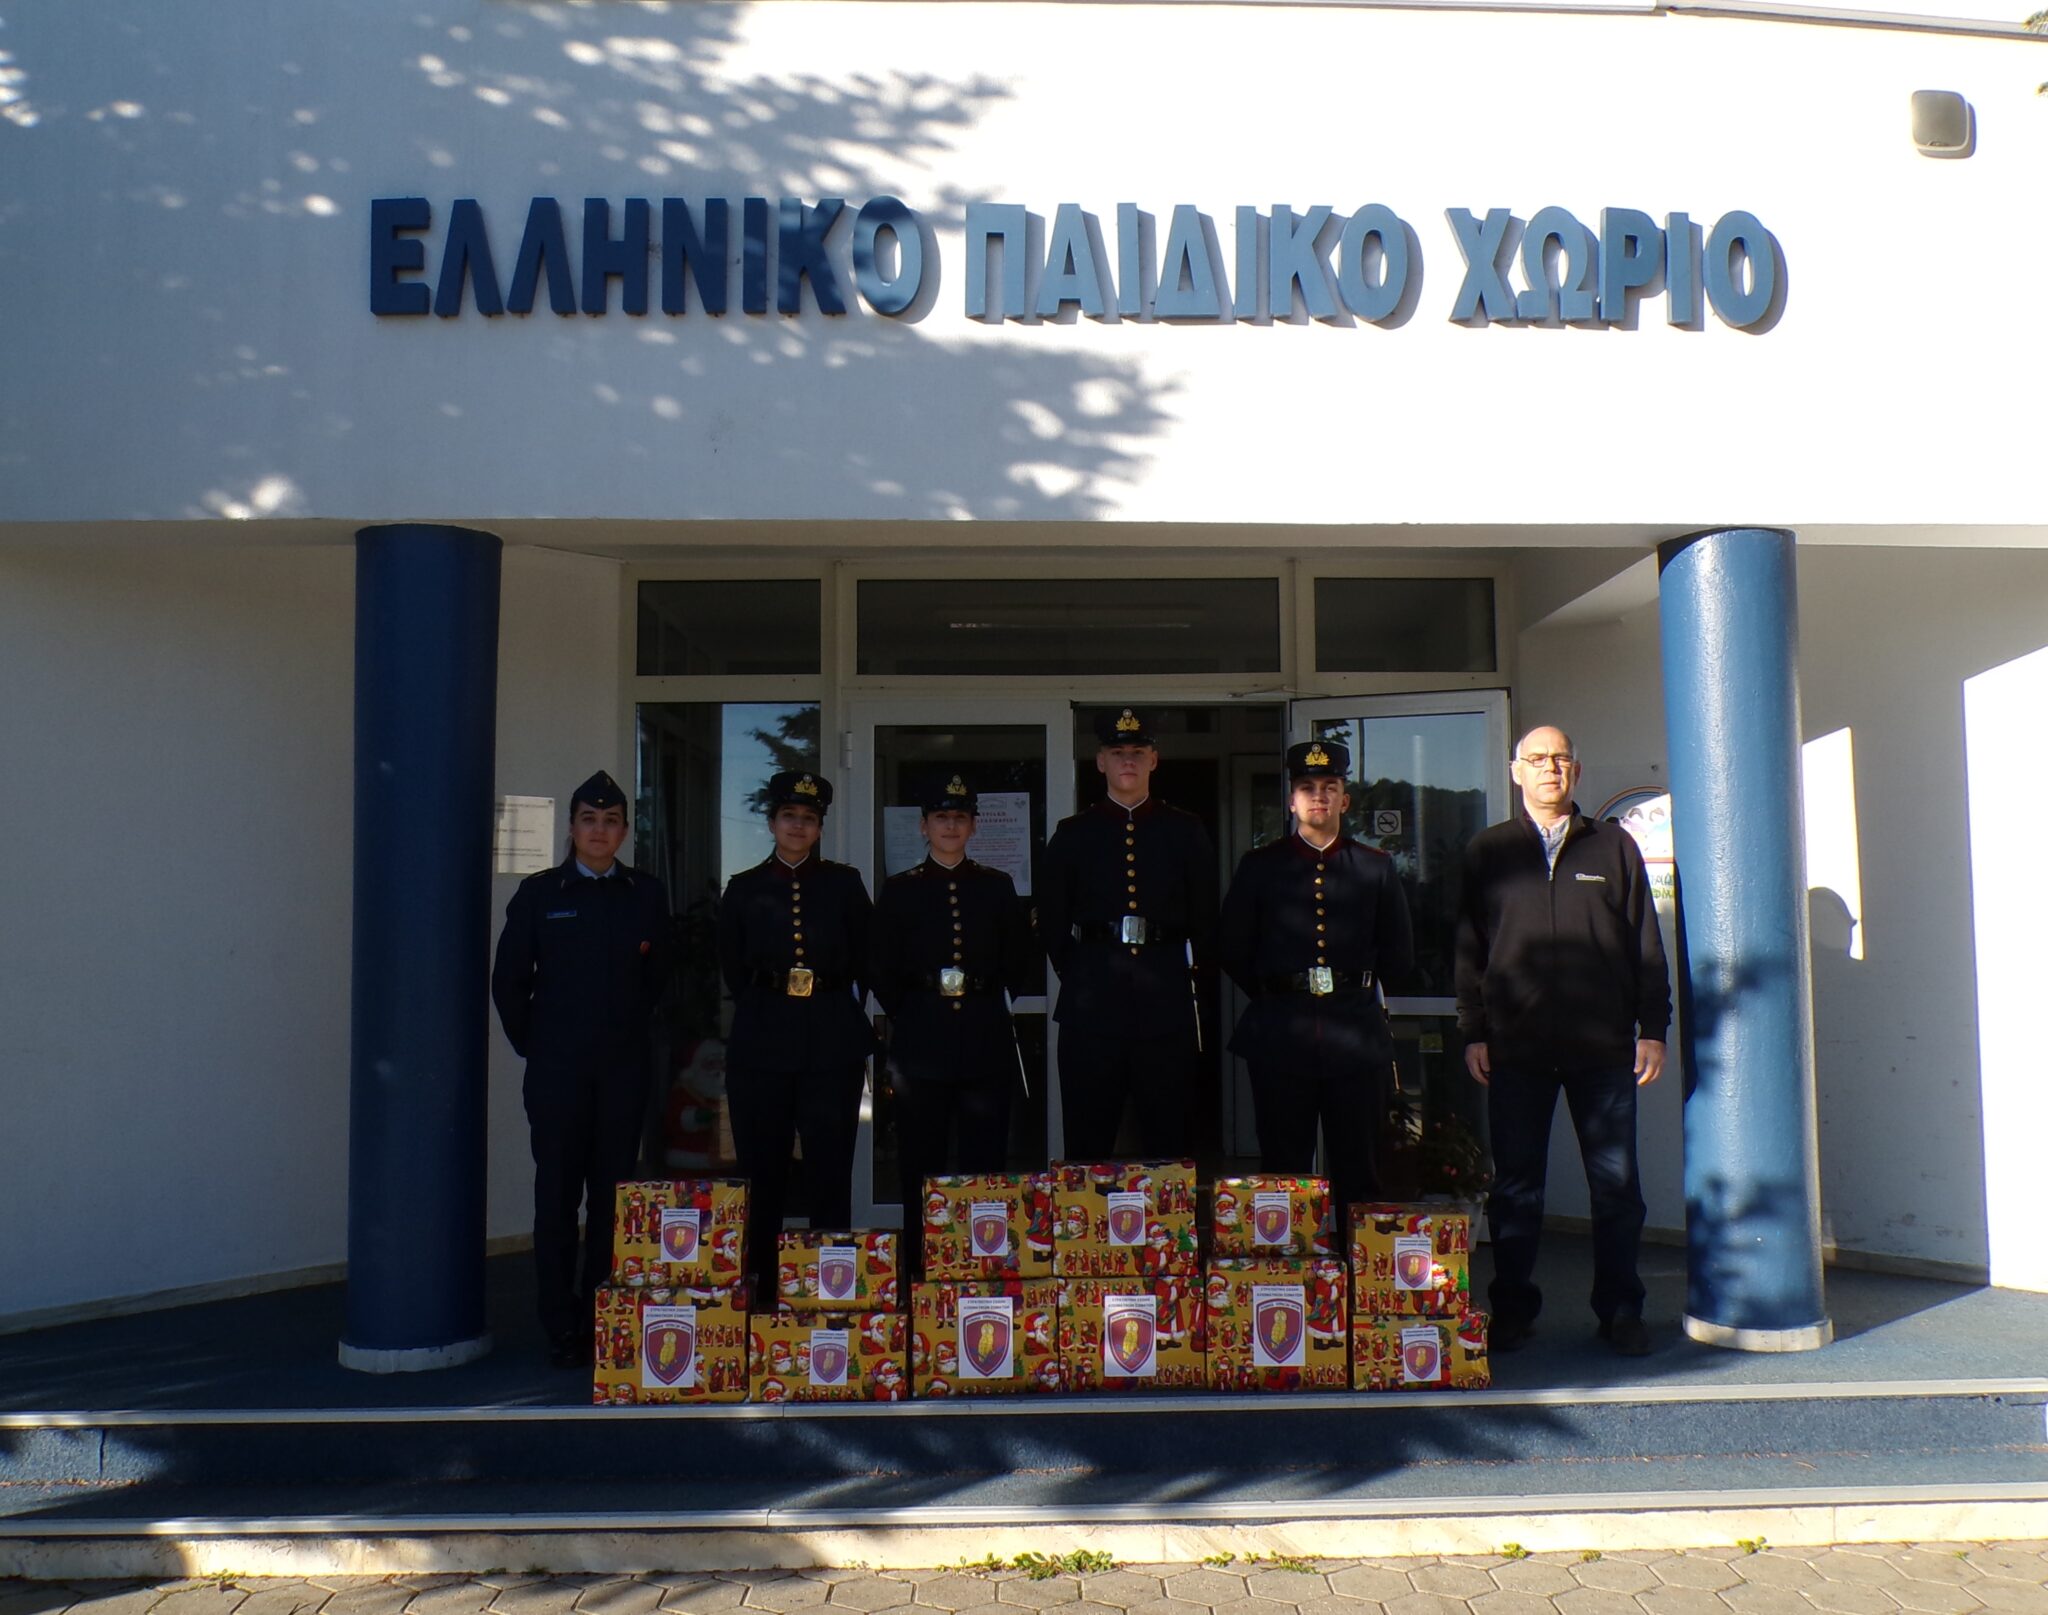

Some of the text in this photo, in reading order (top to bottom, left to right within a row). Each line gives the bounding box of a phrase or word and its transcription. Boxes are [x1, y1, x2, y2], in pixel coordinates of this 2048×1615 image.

[370, 196, 1779, 328] ΕΛΛΗΝΙΚΟ ΠΑΙΔΙΚΟ ΧΩΡΙΟ
